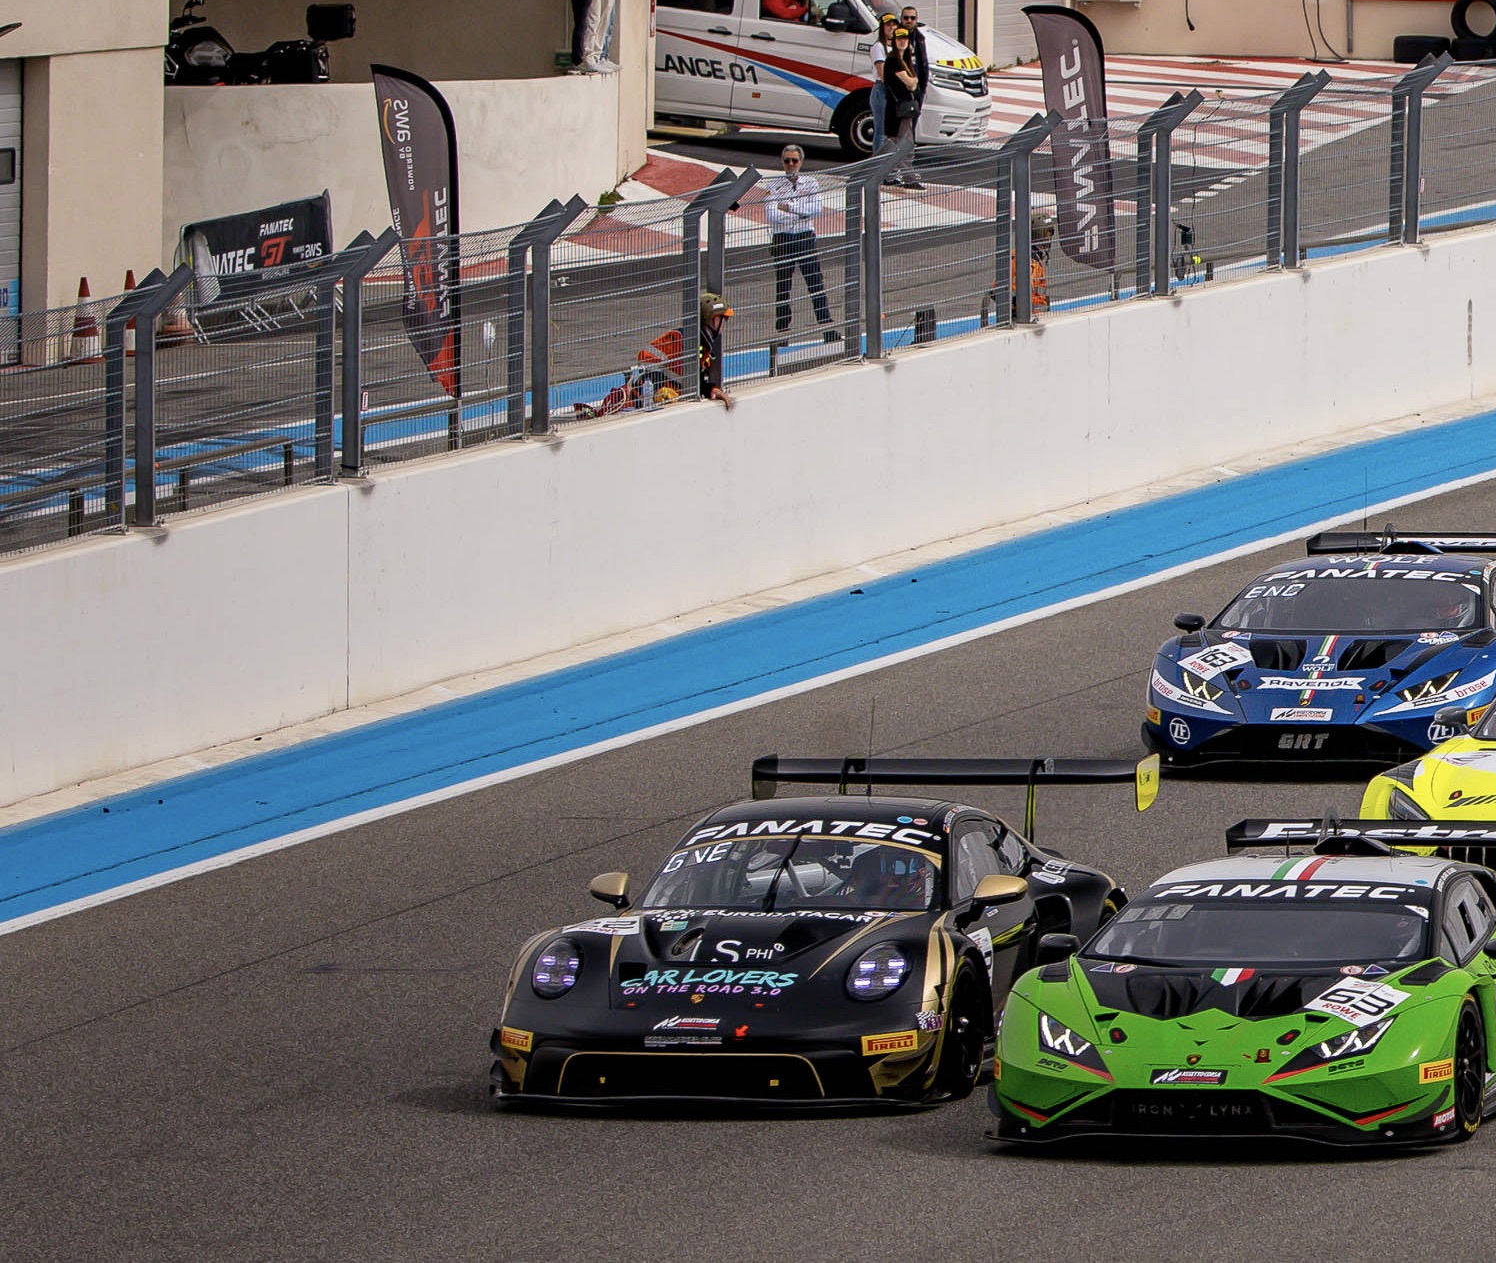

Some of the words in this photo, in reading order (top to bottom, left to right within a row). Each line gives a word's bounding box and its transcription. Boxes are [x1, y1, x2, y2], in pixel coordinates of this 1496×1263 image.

[729, 65, 759, 85] 01
[259, 218, 294, 238] FANATEC
[1263, 568, 1471, 582] FANATEC
[1152, 676, 1174, 698] brose
[1268, 677, 1363, 690] RAVENOL
[1454, 679, 1488, 699] brose
[1172, 723, 1190, 739] ZF
[1278, 732, 1330, 750] GRT
[684, 819, 940, 846] FANATEC
[1157, 884, 1416, 900] FANATEC
[702, 909, 873, 923] EURODATACAR
[683, 969, 800, 987] LOVERS
[623, 986, 648, 995] ON
[657, 984, 687, 994] THE
[696, 984, 743, 994] ROAD
[750, 986, 782, 996] 3.0
[1319, 988, 1397, 1018] 63
[1321, 1002, 1361, 1019] ROWE
[866, 1035, 915, 1052] PIRELLI
[1424, 1064, 1454, 1080] PIRELLI
[1131, 1104, 1173, 1117] IRON
[1209, 1103, 1255, 1117] LYNX
